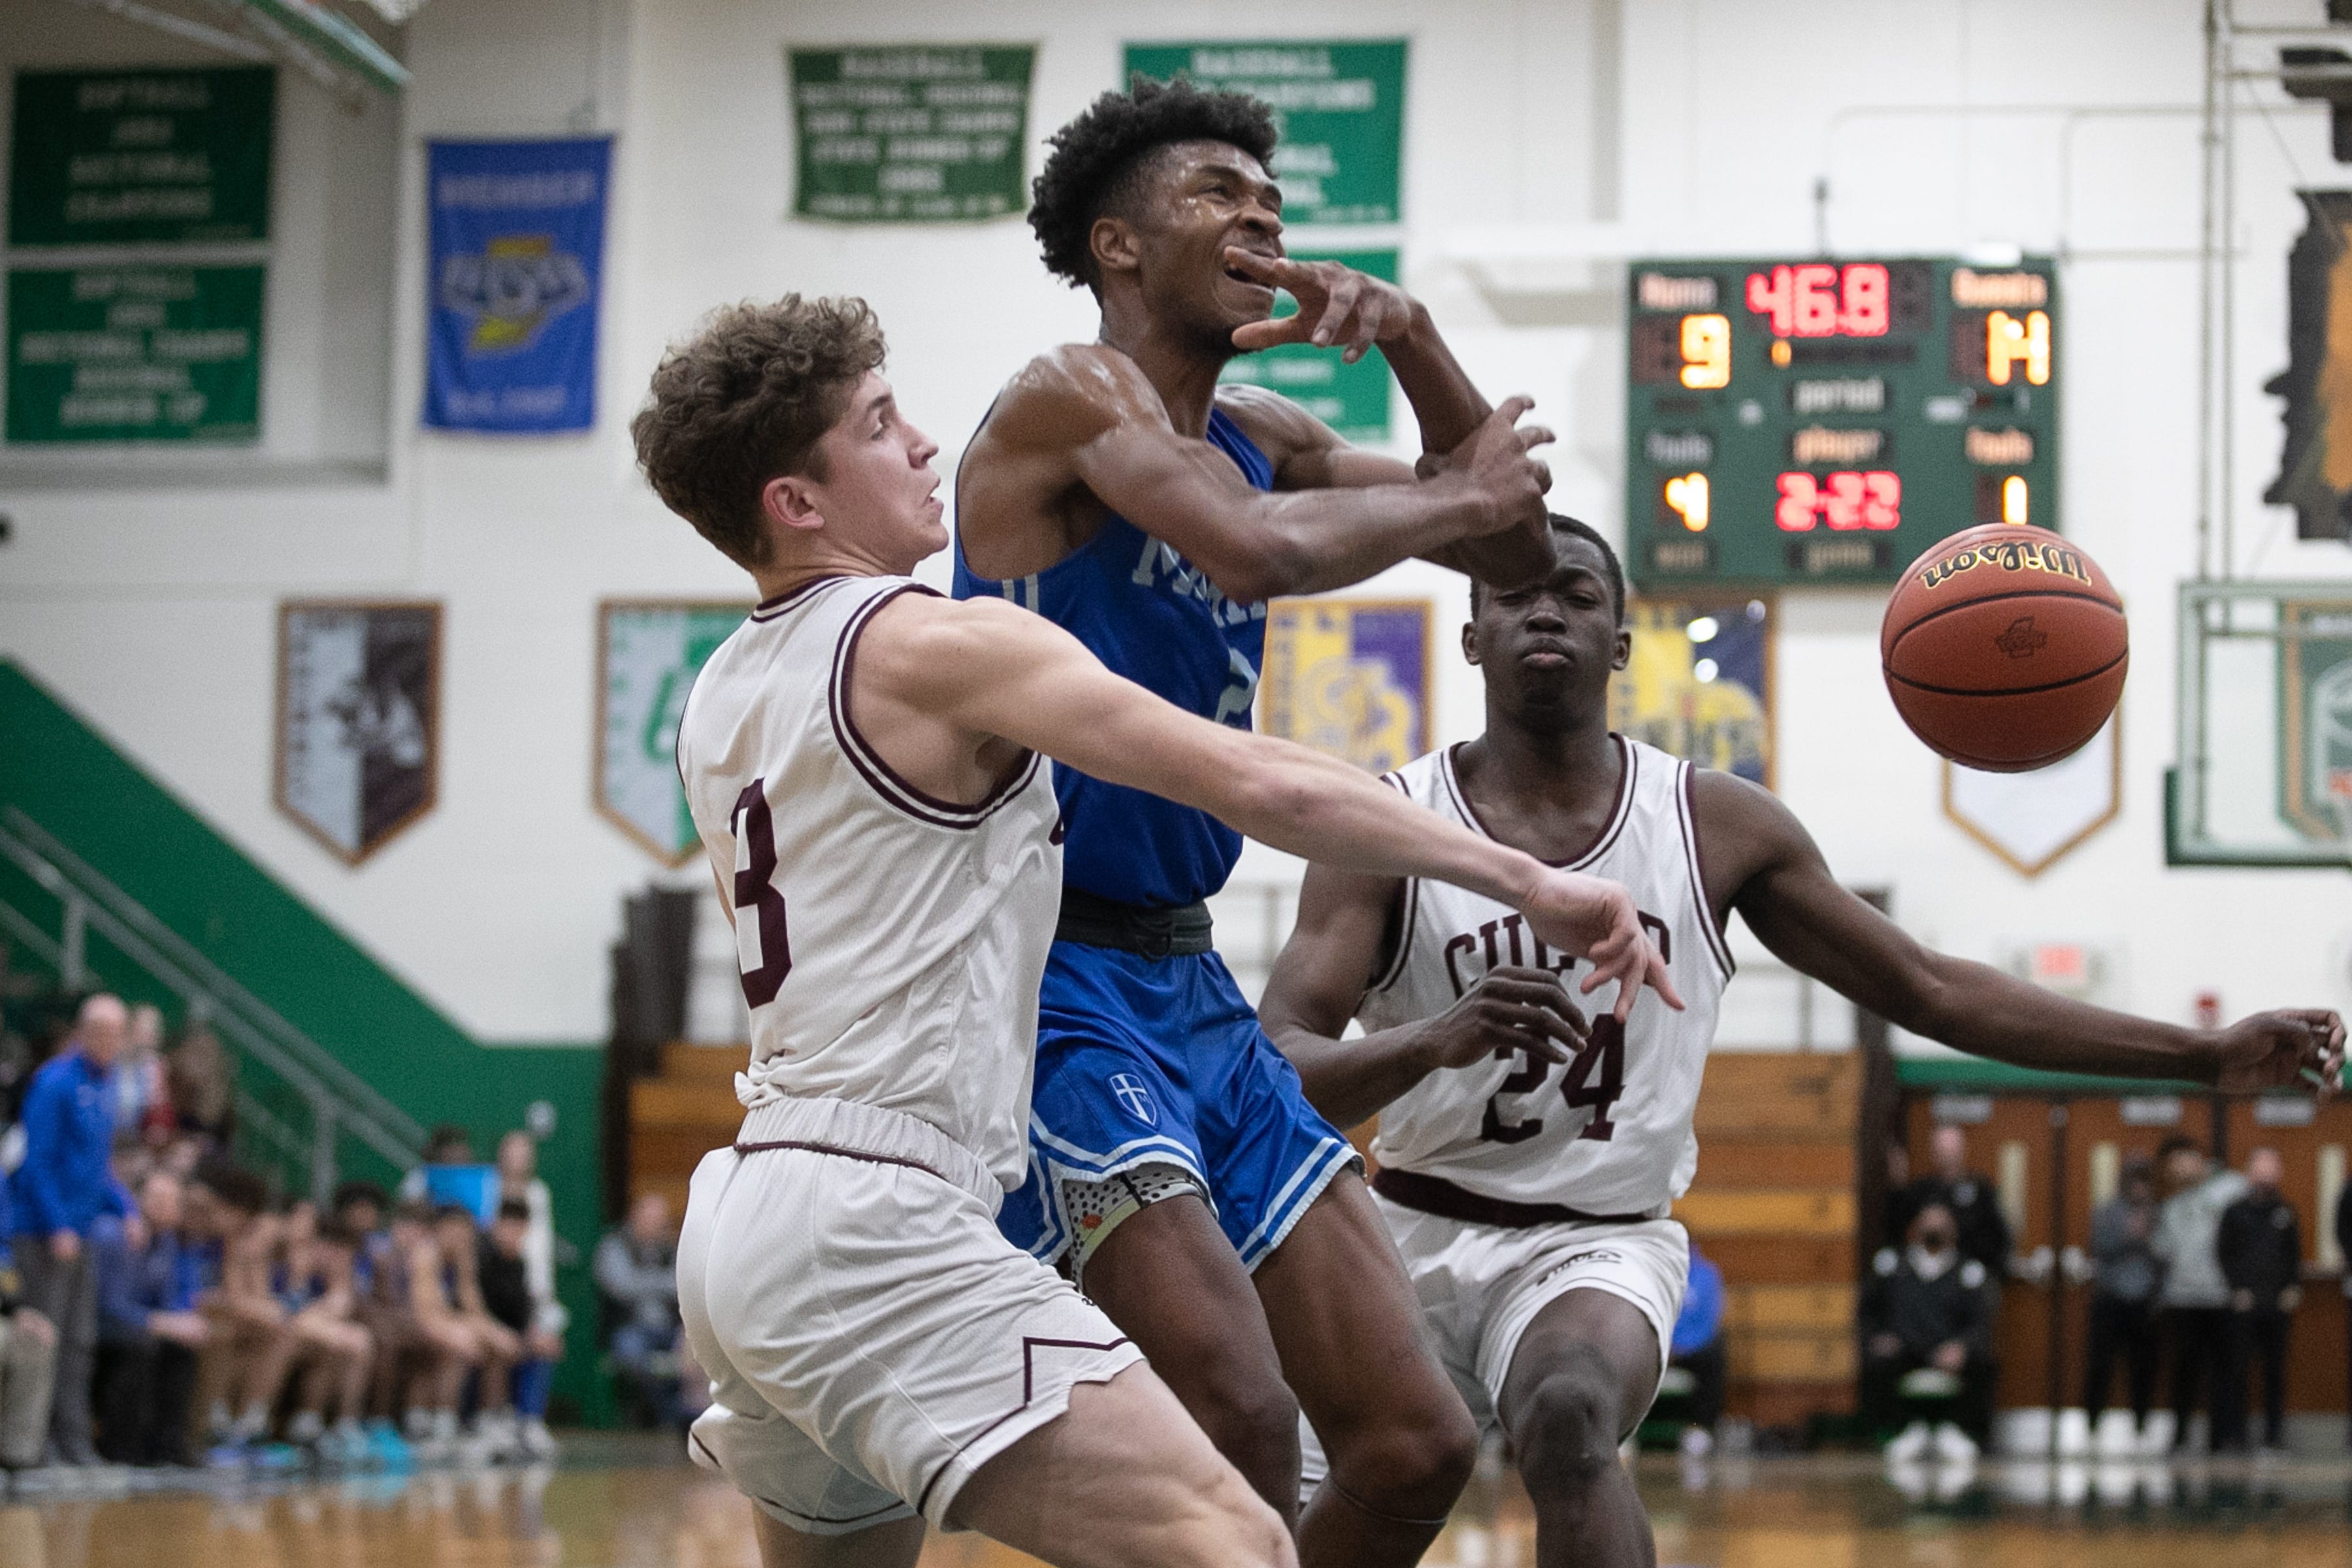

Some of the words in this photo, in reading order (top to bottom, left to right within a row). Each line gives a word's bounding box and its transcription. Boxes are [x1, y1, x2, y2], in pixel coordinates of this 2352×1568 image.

[1678, 314, 1731, 389] 9
[1920, 542, 2092, 589] Wilson
[730, 777, 792, 1010] 3
[1481, 1013, 1625, 1144] 24
